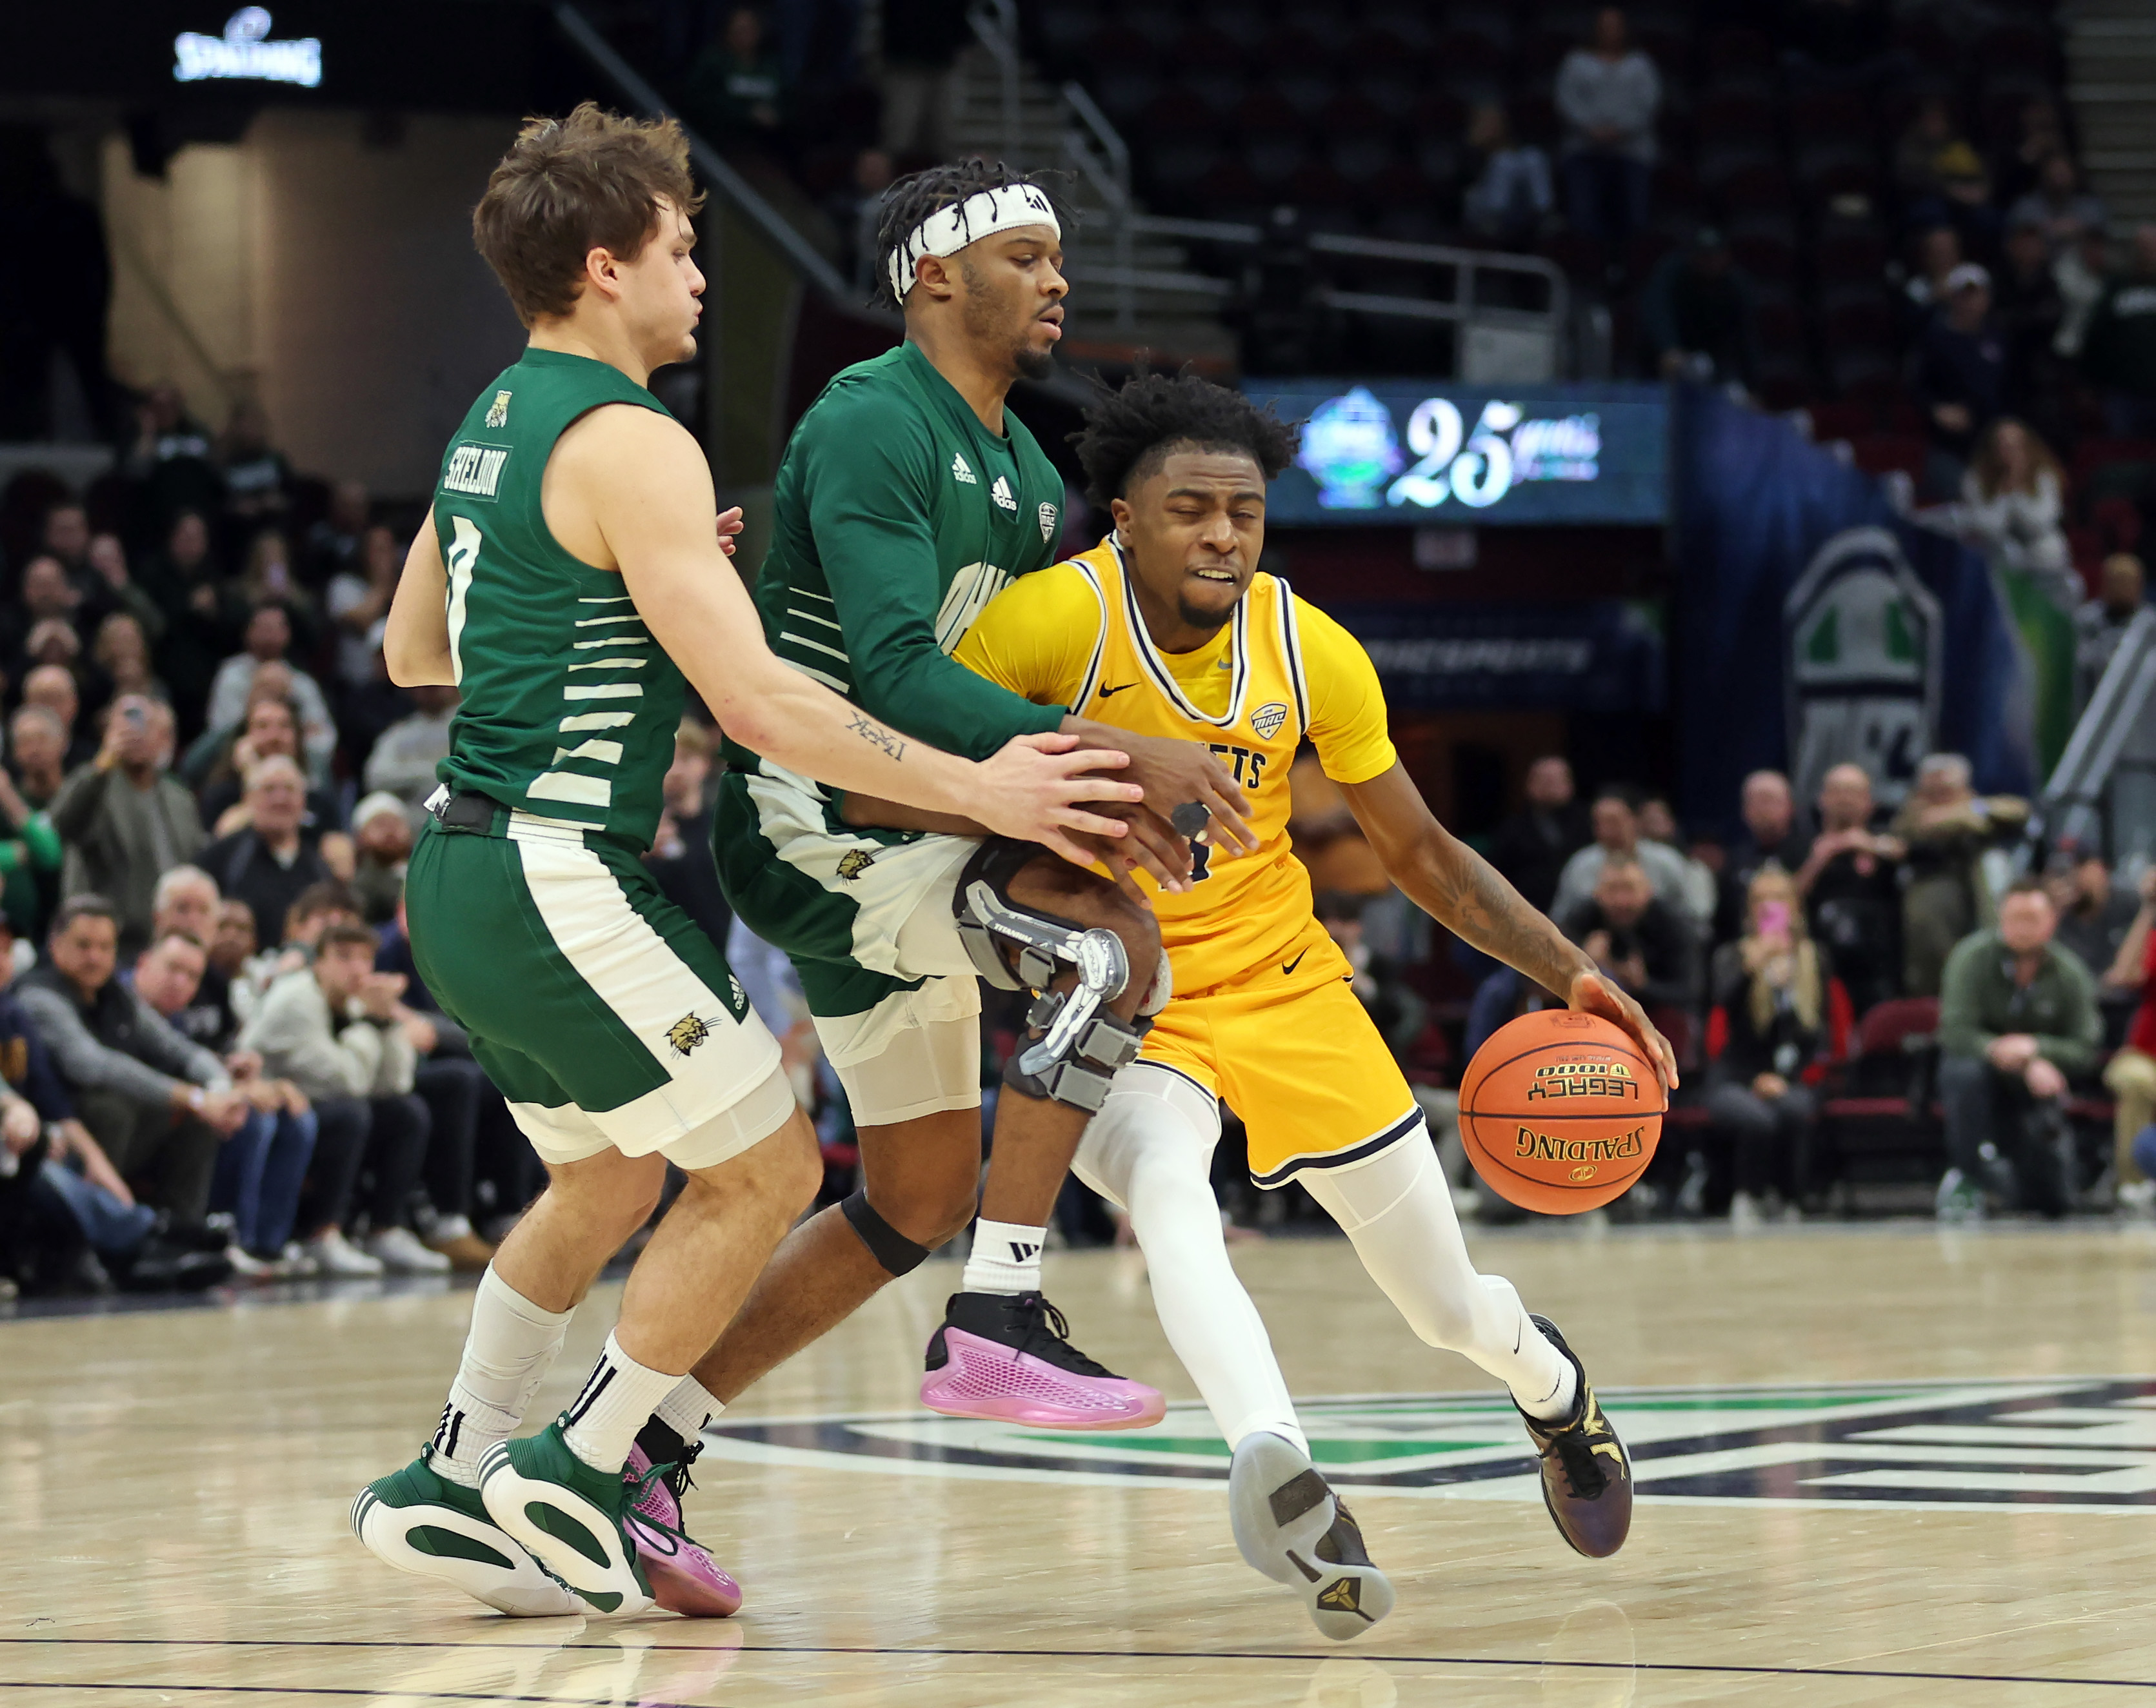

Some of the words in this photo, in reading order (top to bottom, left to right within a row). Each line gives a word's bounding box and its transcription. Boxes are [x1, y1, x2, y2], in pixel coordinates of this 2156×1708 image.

[1386, 397, 1521, 508] 25
[444, 446, 508, 497] SHELDON
[1253, 712, 1285, 730] MAC
[993, 922, 1033, 944] TITANIUM
[1527, 1077, 1639, 1103] LEGACY
[1515, 1124, 1645, 1162] SPALDING
